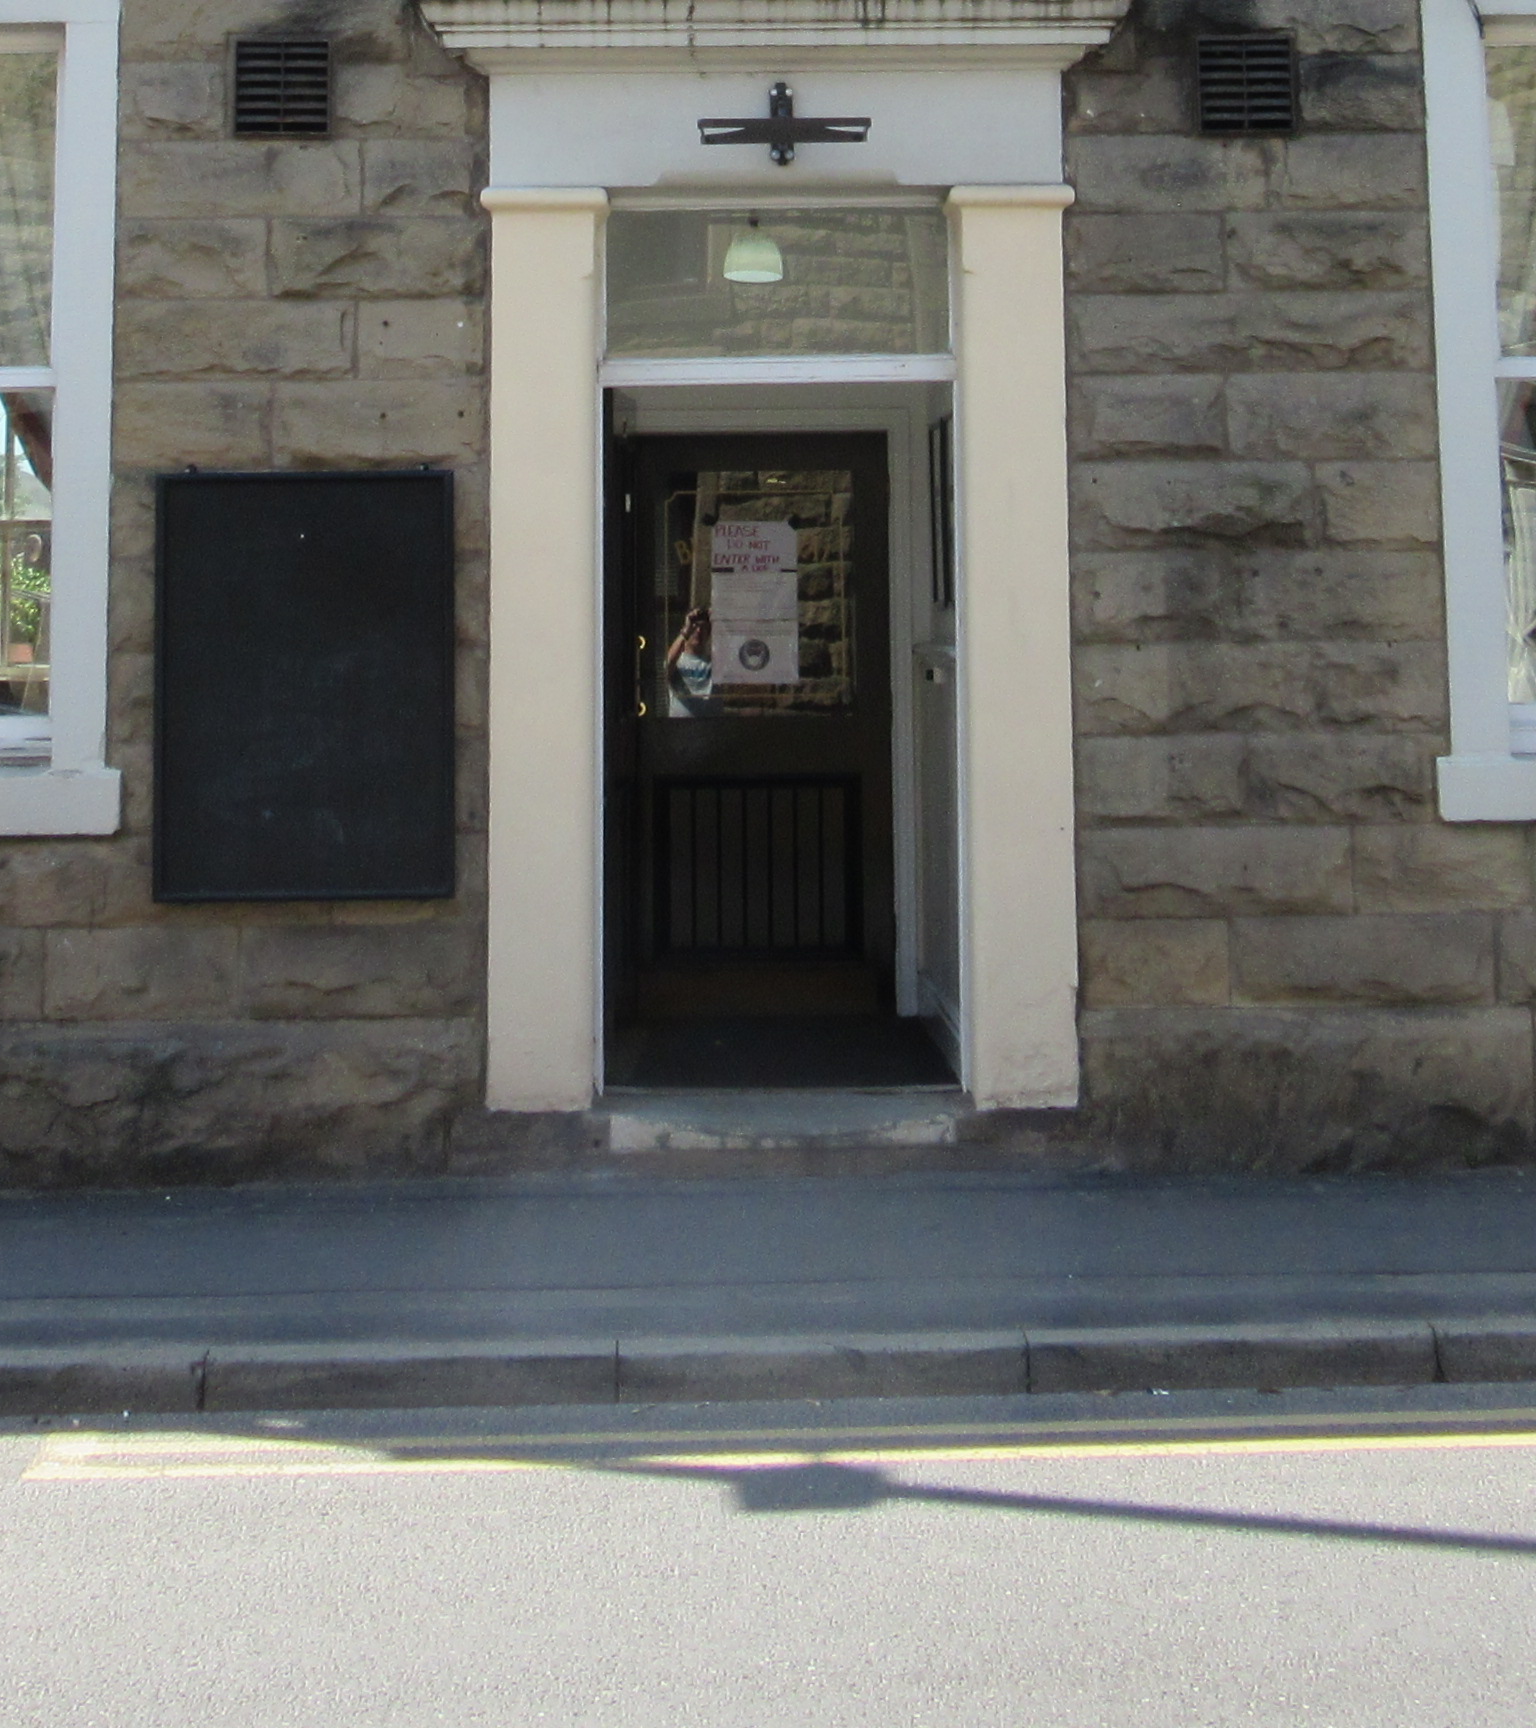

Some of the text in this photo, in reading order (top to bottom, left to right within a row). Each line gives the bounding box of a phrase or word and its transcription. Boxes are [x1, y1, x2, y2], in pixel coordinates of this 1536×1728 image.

[714, 525, 760, 538] PLEASE
[749, 539, 771, 551] NOT
[714, 553, 751, 566] ENTER
